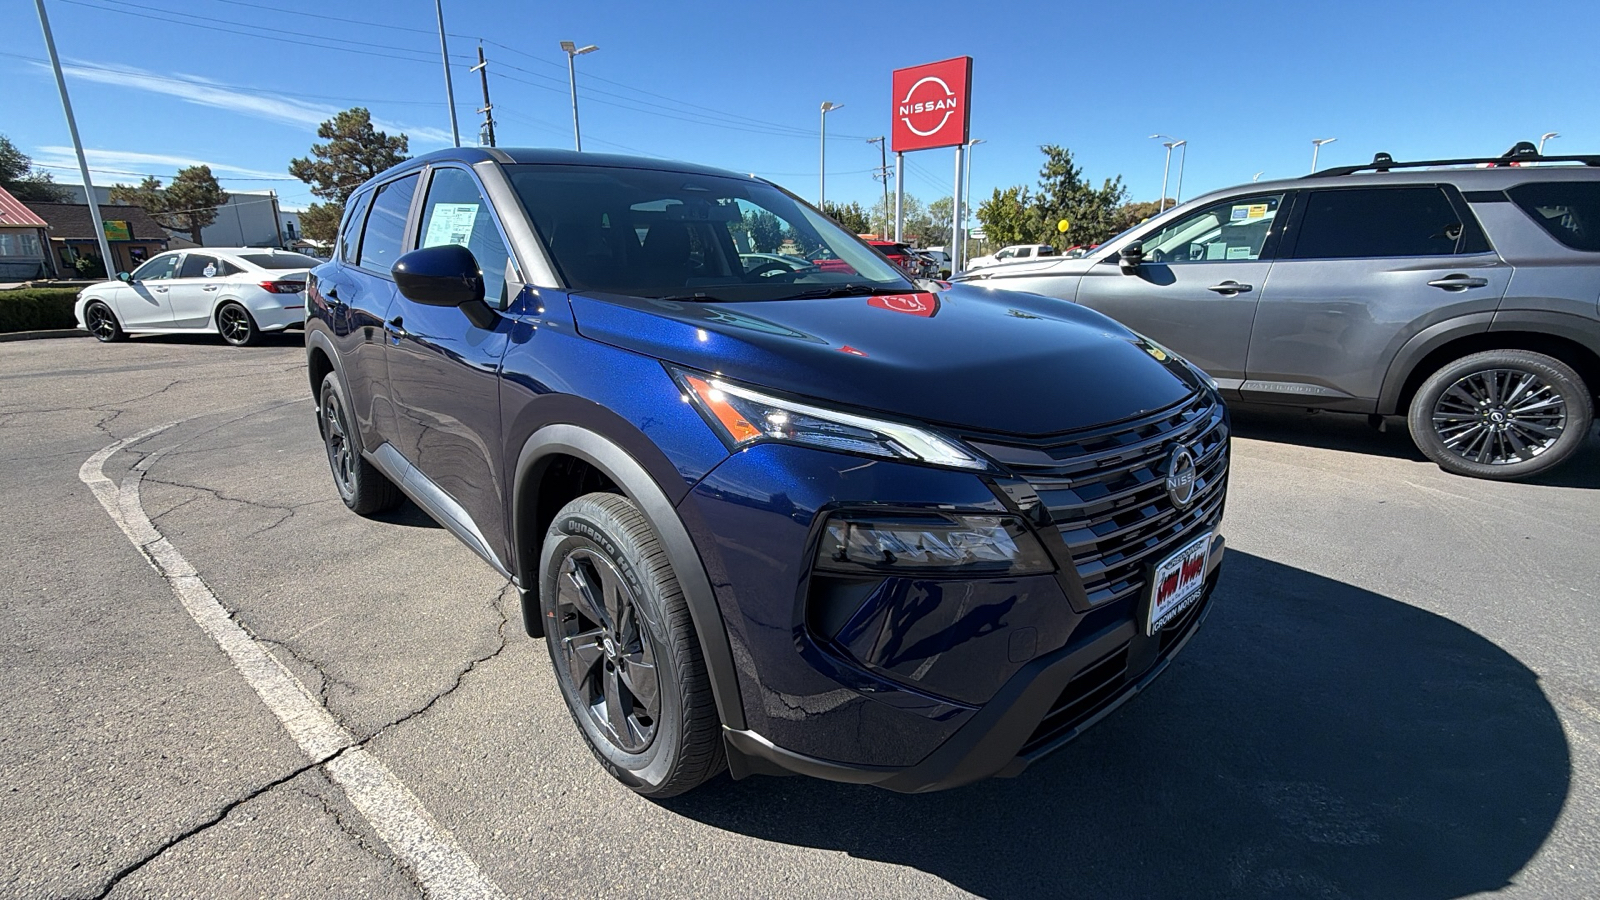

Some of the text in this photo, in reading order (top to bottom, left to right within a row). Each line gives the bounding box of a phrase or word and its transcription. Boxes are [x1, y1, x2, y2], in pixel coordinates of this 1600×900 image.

[899, 97, 957, 116] NISSAN
[1168, 473, 1193, 489] NISS
[568, 520, 642, 597] Dynapro HP2
[1154, 608, 1177, 631] CROWN
[1177, 588, 1202, 613] MOTORS
